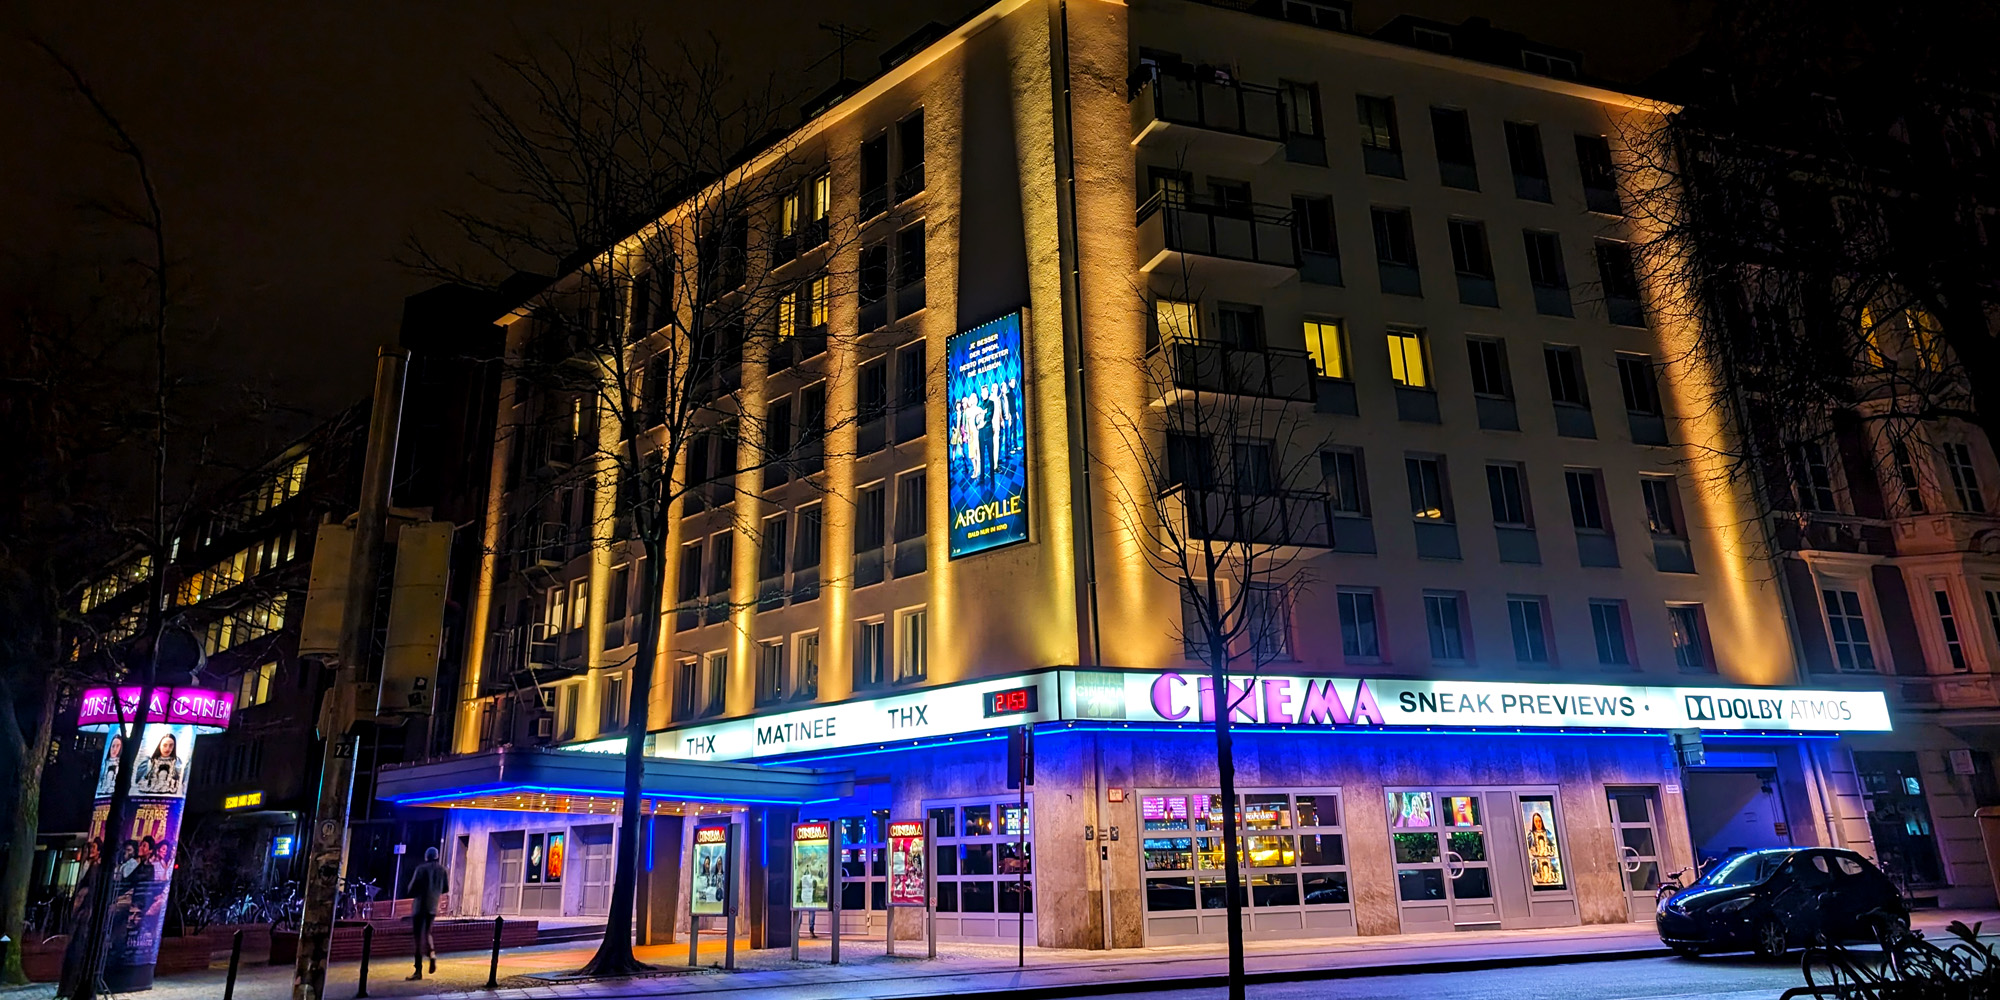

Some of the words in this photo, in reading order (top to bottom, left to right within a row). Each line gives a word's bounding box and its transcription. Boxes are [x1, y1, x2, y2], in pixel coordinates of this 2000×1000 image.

[977, 333, 999, 347] BESSER
[954, 495, 1022, 530] ARGYLLE
[1150, 672, 1386, 725] CINEMA
[1399, 691, 1494, 714] SNEAK
[1500, 693, 1636, 717] PREVIEWS
[1717, 698, 1783, 720] DOLBY
[1790, 699, 1852, 721] ATMOS
[887, 704, 929, 729] THX
[757, 716, 837, 746] MATINEE
[686, 734, 716, 756] THX
[696, 829, 726, 843] CINEMA
[796, 826, 828, 840] CINEMA
[890, 824, 923, 837] CINEMA
